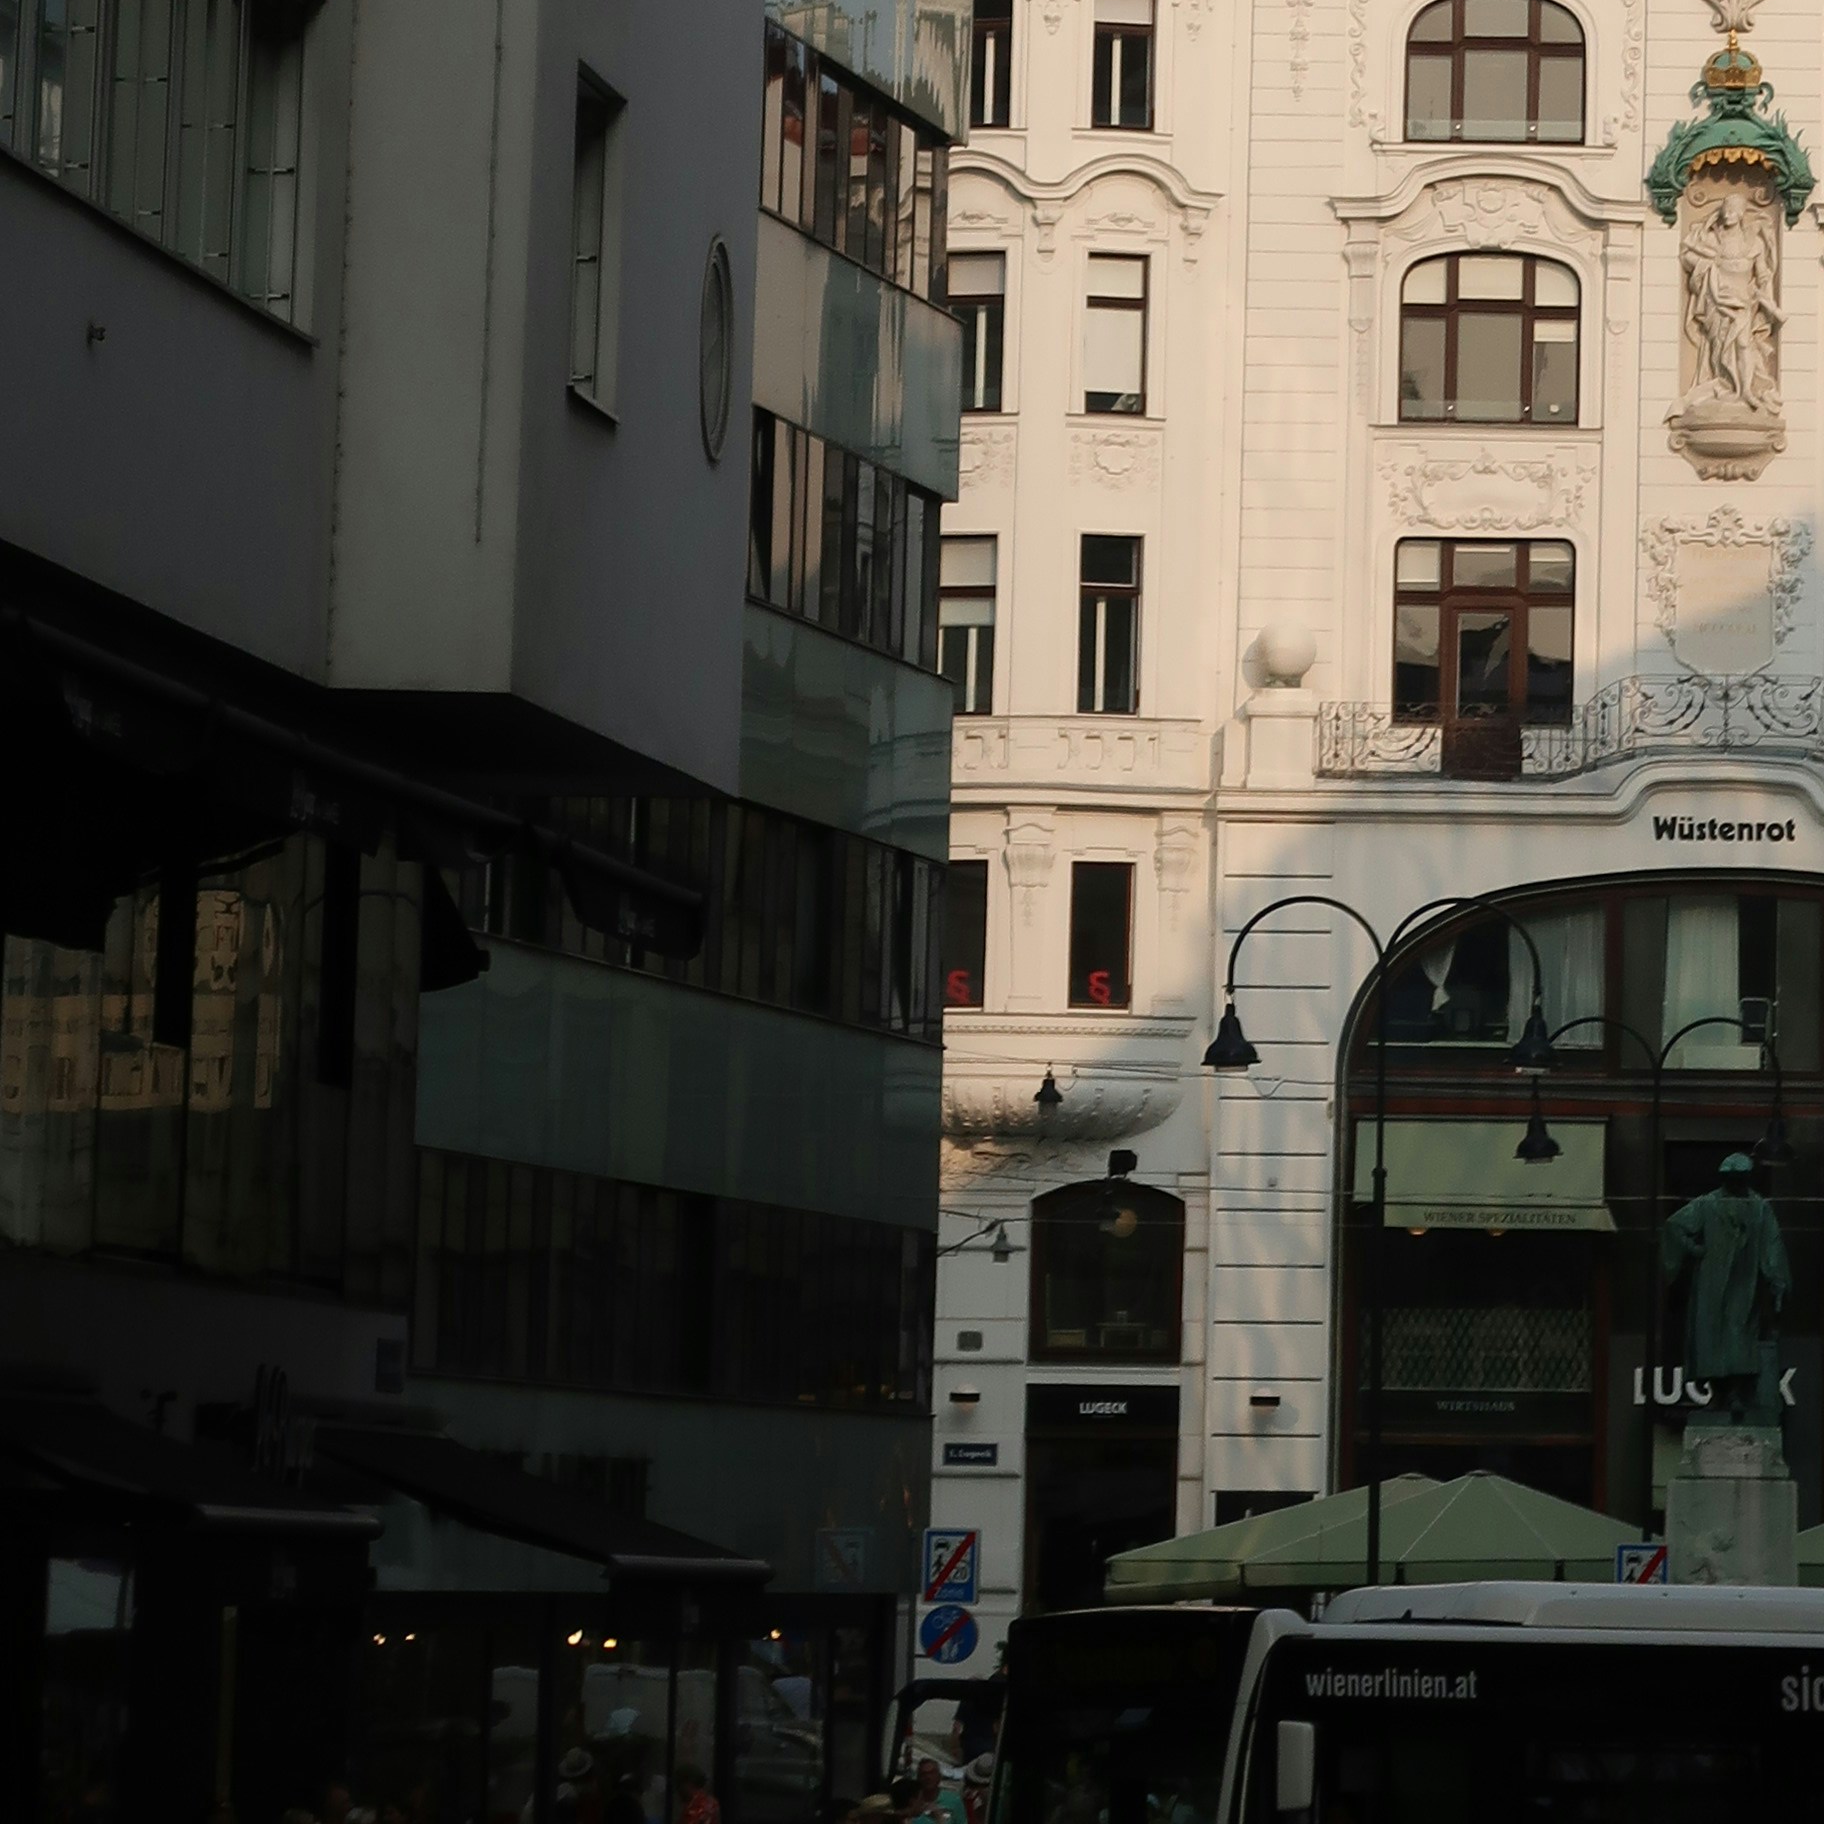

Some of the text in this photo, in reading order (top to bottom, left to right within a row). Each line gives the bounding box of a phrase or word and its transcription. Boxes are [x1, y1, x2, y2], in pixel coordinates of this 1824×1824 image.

[1652, 815, 1796, 842] Wüstenrot
[1423, 1212, 1475, 1224] WIENER
[1632, 1365, 1798, 1406] LUGK
[1079, 1402, 1128, 1414] LUGECK
[1436, 1400, 1516, 1412] WIRTSHAUS
[1305, 1666, 1478, 1699] wienerlinien.at
